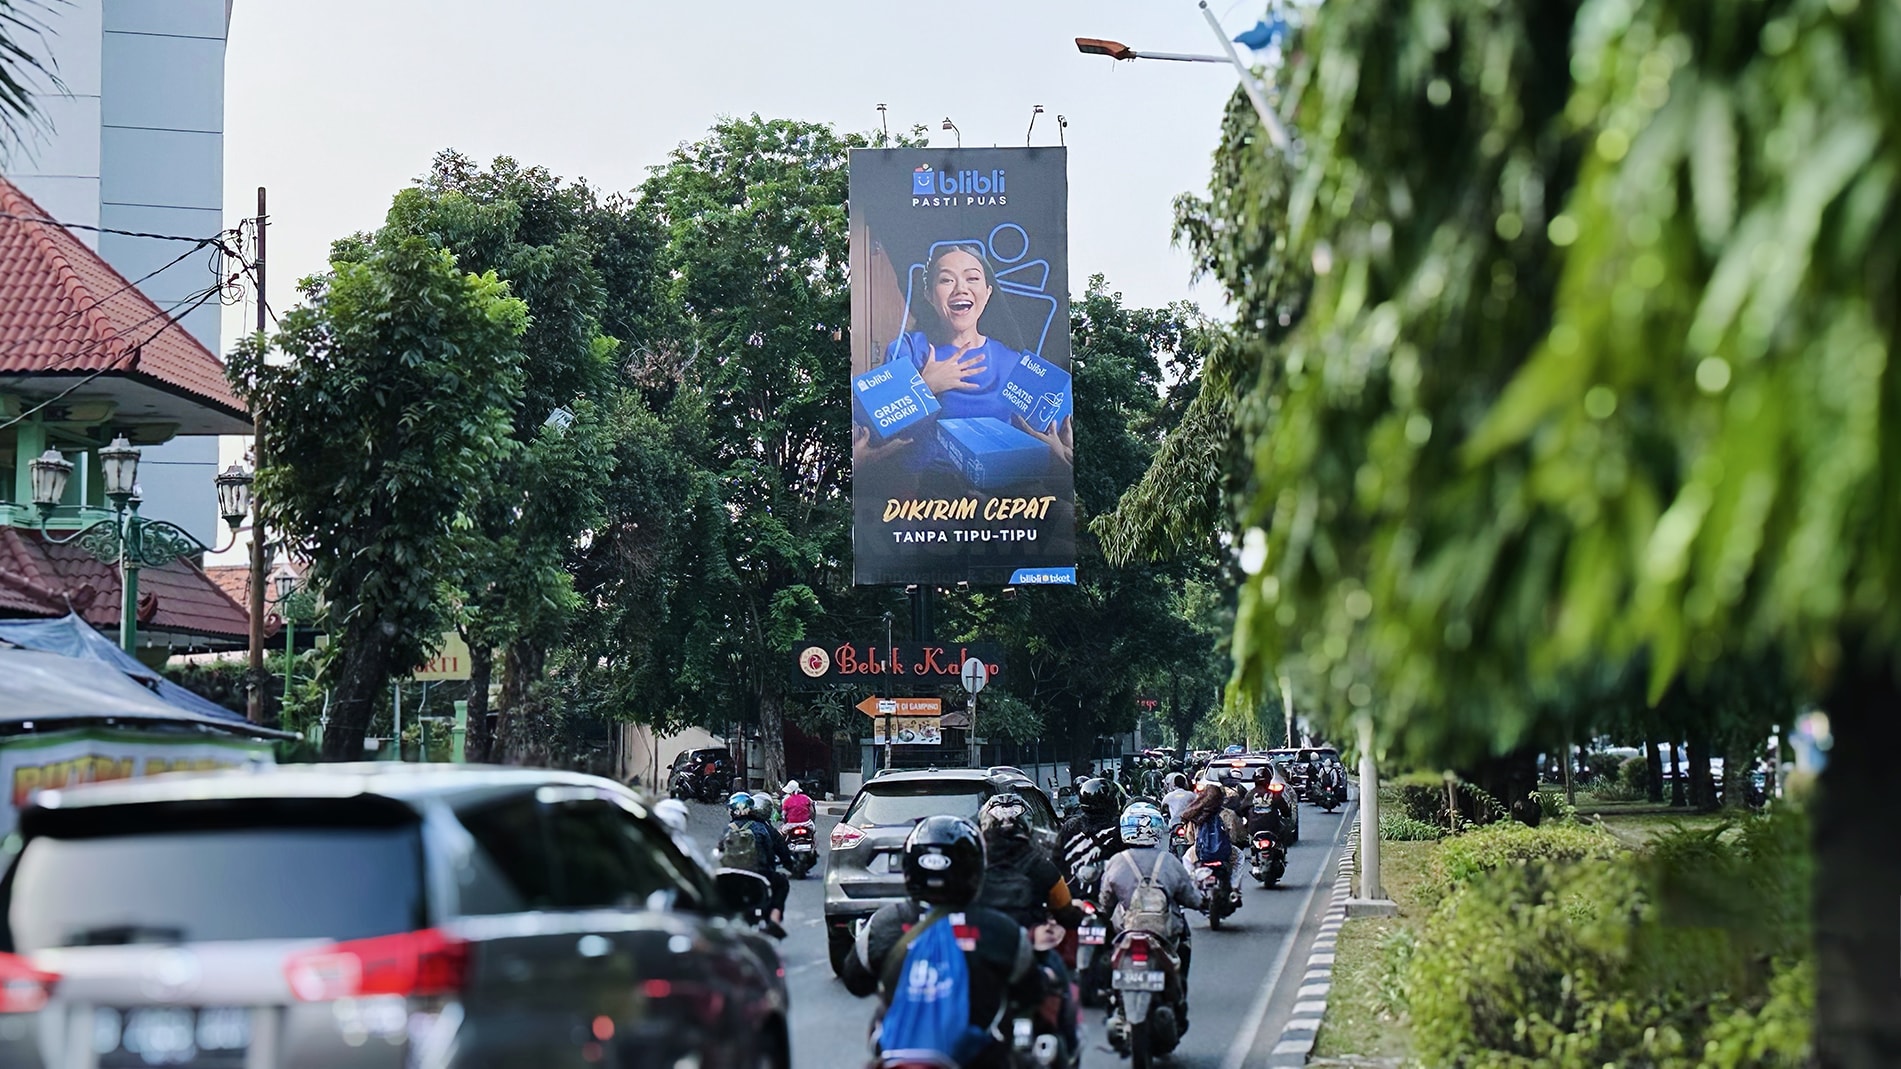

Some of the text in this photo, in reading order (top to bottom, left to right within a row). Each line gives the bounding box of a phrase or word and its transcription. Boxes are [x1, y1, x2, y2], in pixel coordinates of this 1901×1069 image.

[939, 170, 1006, 194] blibli
[912, 196, 1007, 207] PASTI PUAS
[865, 369, 894, 388] blibli
[1002, 388, 1029, 413] ONGKIR
[1006, 381, 1034, 405] GRATIS
[874, 395, 914, 419] GRATIS
[880, 404, 919, 428] ONGKIR
[882, 496, 1056, 523] DIKIRIM CEPAT
[893, 529, 1038, 543] TANPA TIPU-TIPU
[835, 642, 905, 675] Bebk
